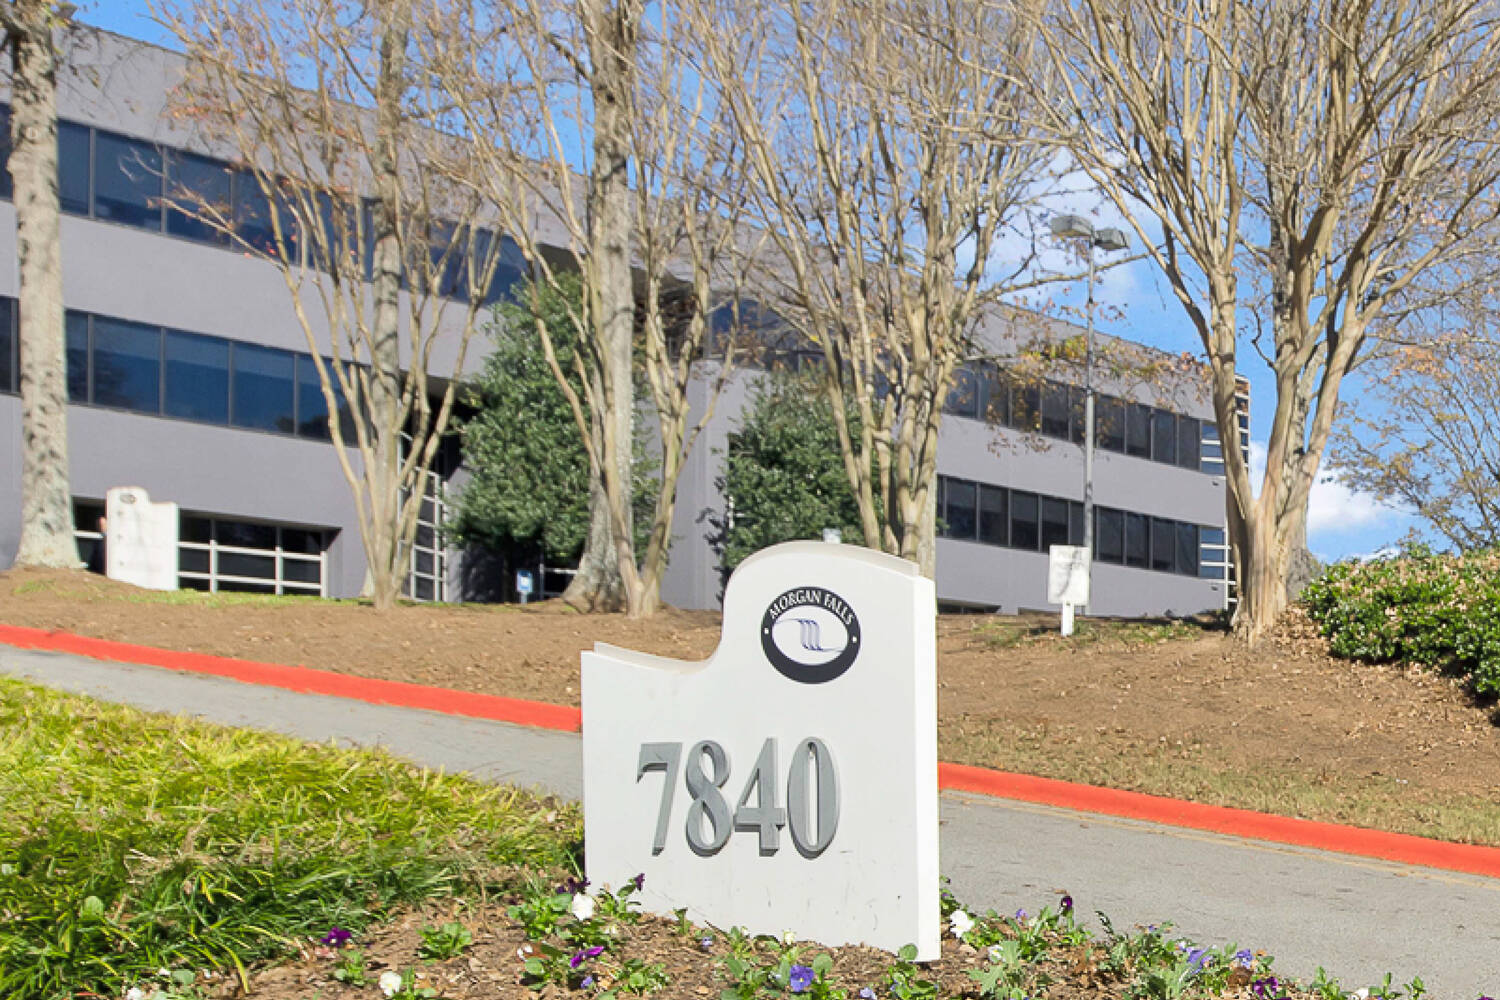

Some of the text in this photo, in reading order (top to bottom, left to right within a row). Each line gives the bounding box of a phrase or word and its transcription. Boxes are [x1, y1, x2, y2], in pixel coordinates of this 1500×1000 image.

[769, 590, 854, 625] MORGAN FALLS
[636, 736, 840, 861] 7840
